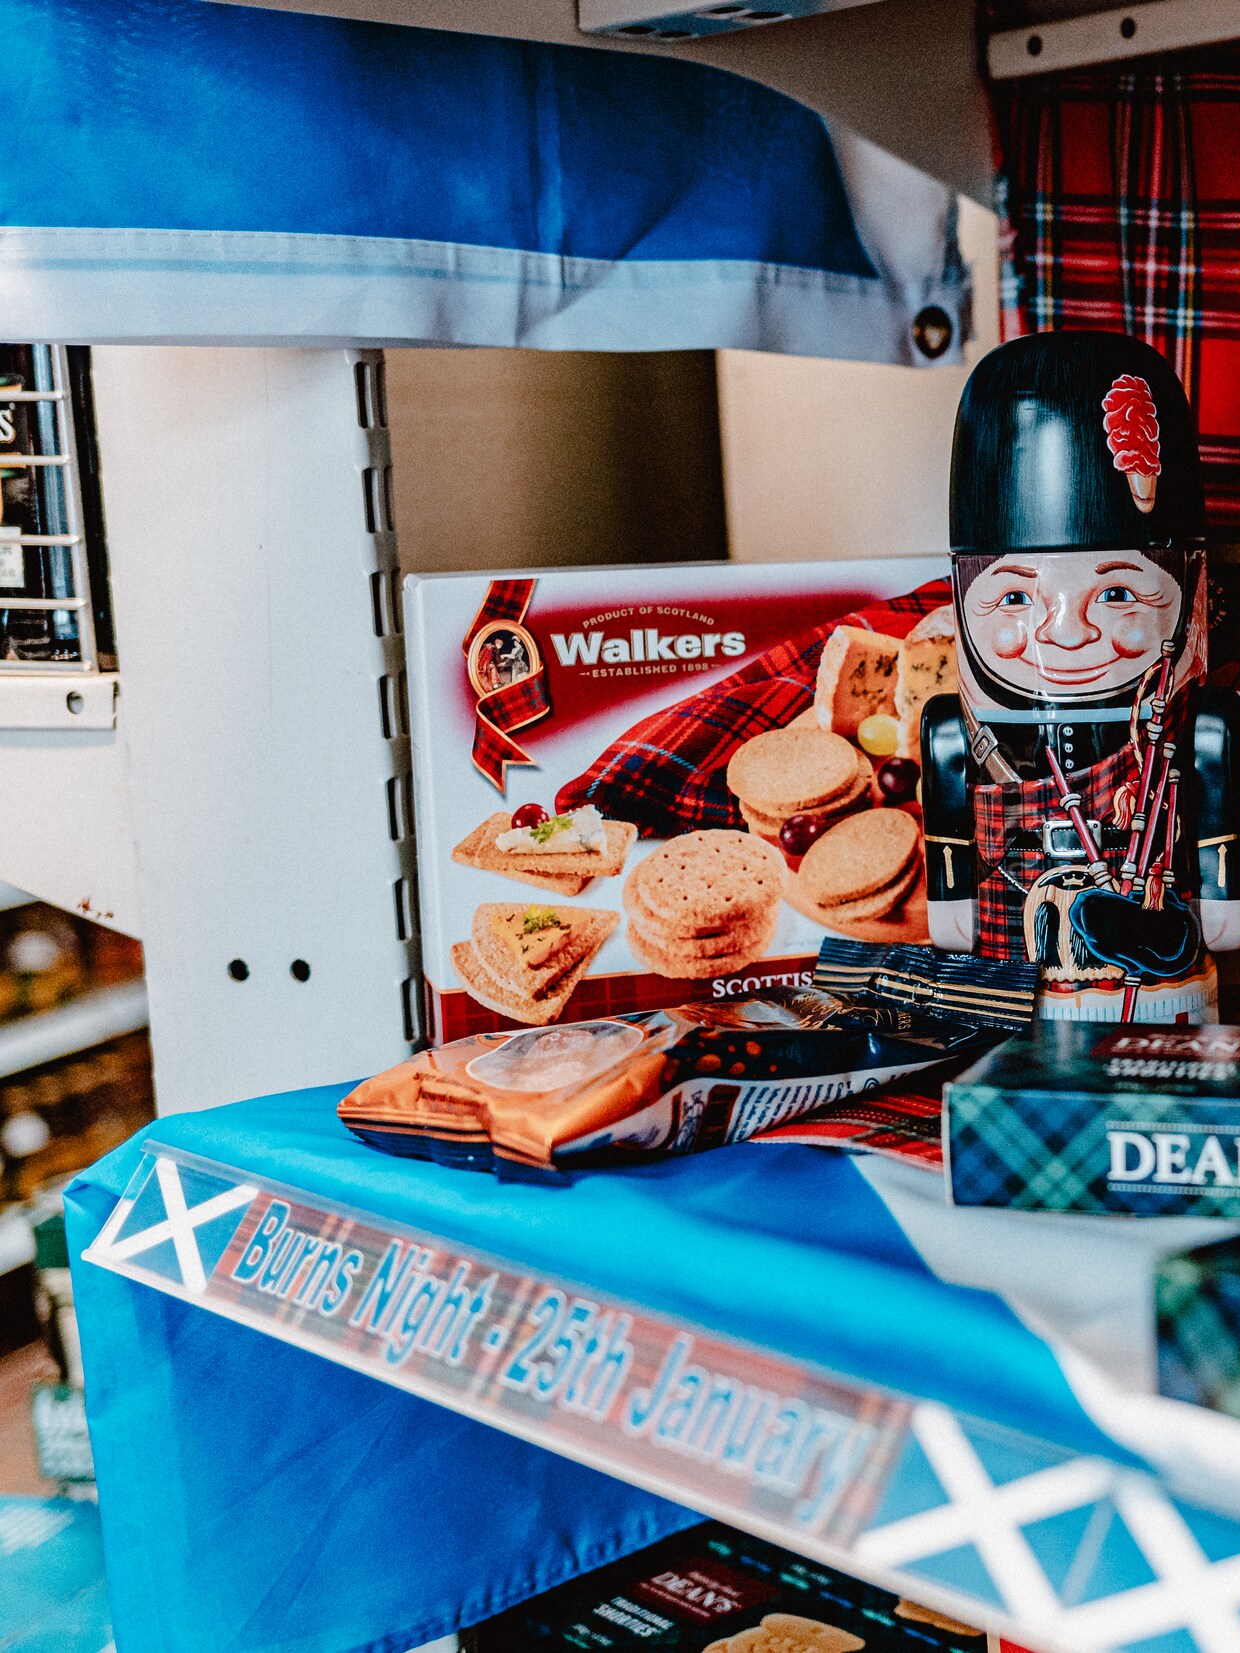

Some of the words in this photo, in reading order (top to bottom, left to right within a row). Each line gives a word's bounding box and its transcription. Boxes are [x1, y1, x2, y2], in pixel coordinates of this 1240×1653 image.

[582, 607, 635, 629] PRODUCT
[639, 606, 654, 616] OF
[656, 606, 716, 627] SCOTLAND
[550, 628, 747, 667] Walkers
[592, 663, 677, 678] ESTABLISHED
[682, 662, 709, 672] 1898
[712, 970, 815, 998] SCOTTIS
[230, 1198, 364, 1317] Burns
[347, 1237, 500, 1365] Night
[500, 1287, 635, 1422] 25th
[622, 1330, 876, 1530] January
